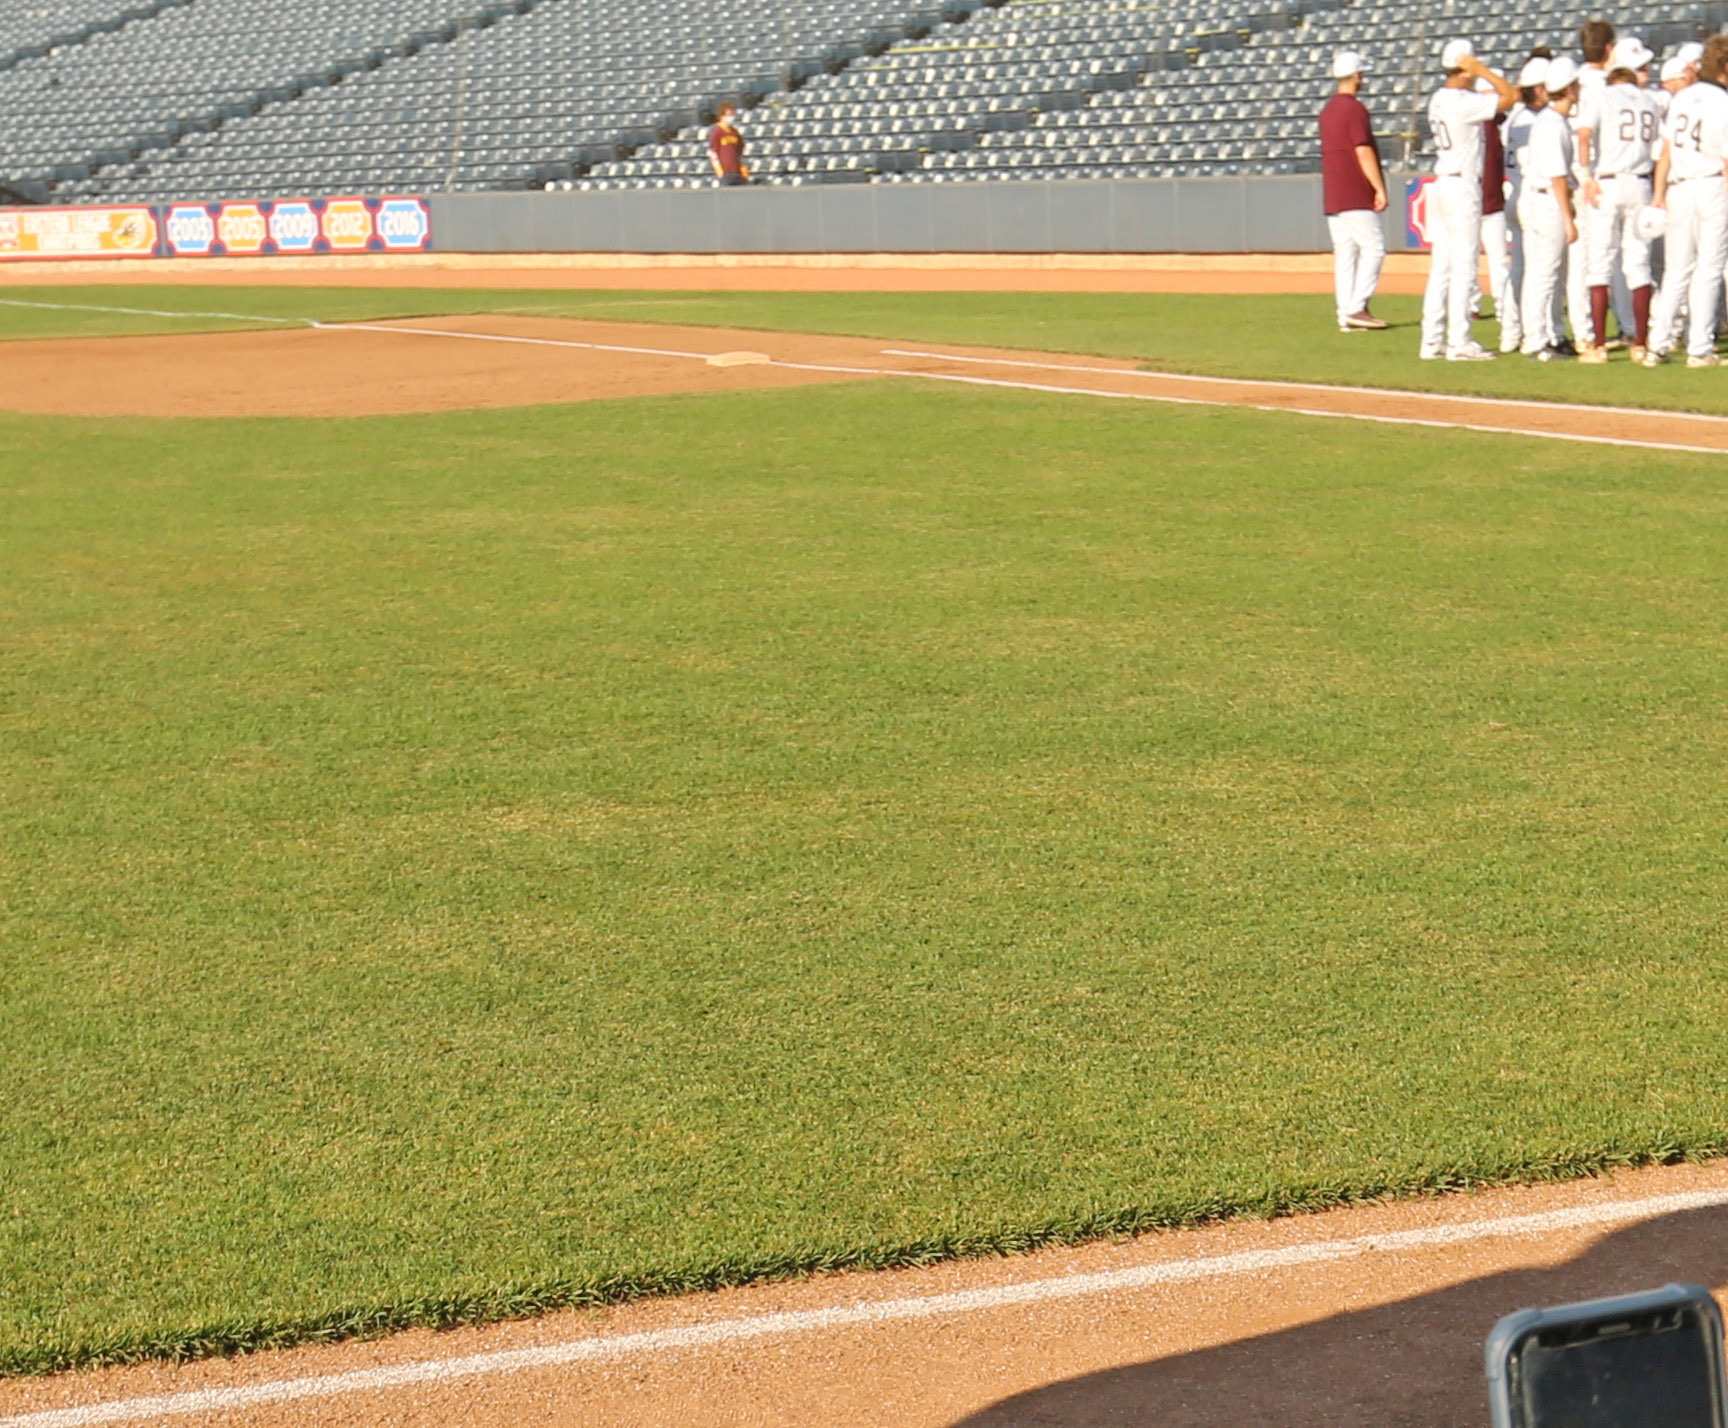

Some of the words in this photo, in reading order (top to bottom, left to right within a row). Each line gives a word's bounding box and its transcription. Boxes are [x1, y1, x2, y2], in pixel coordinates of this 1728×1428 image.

[1619, 107, 1654, 143] 28
[1674, 113, 1702, 152] 24
[330, 212, 364, 237] 2012
[384, 210, 420, 236] 2016
